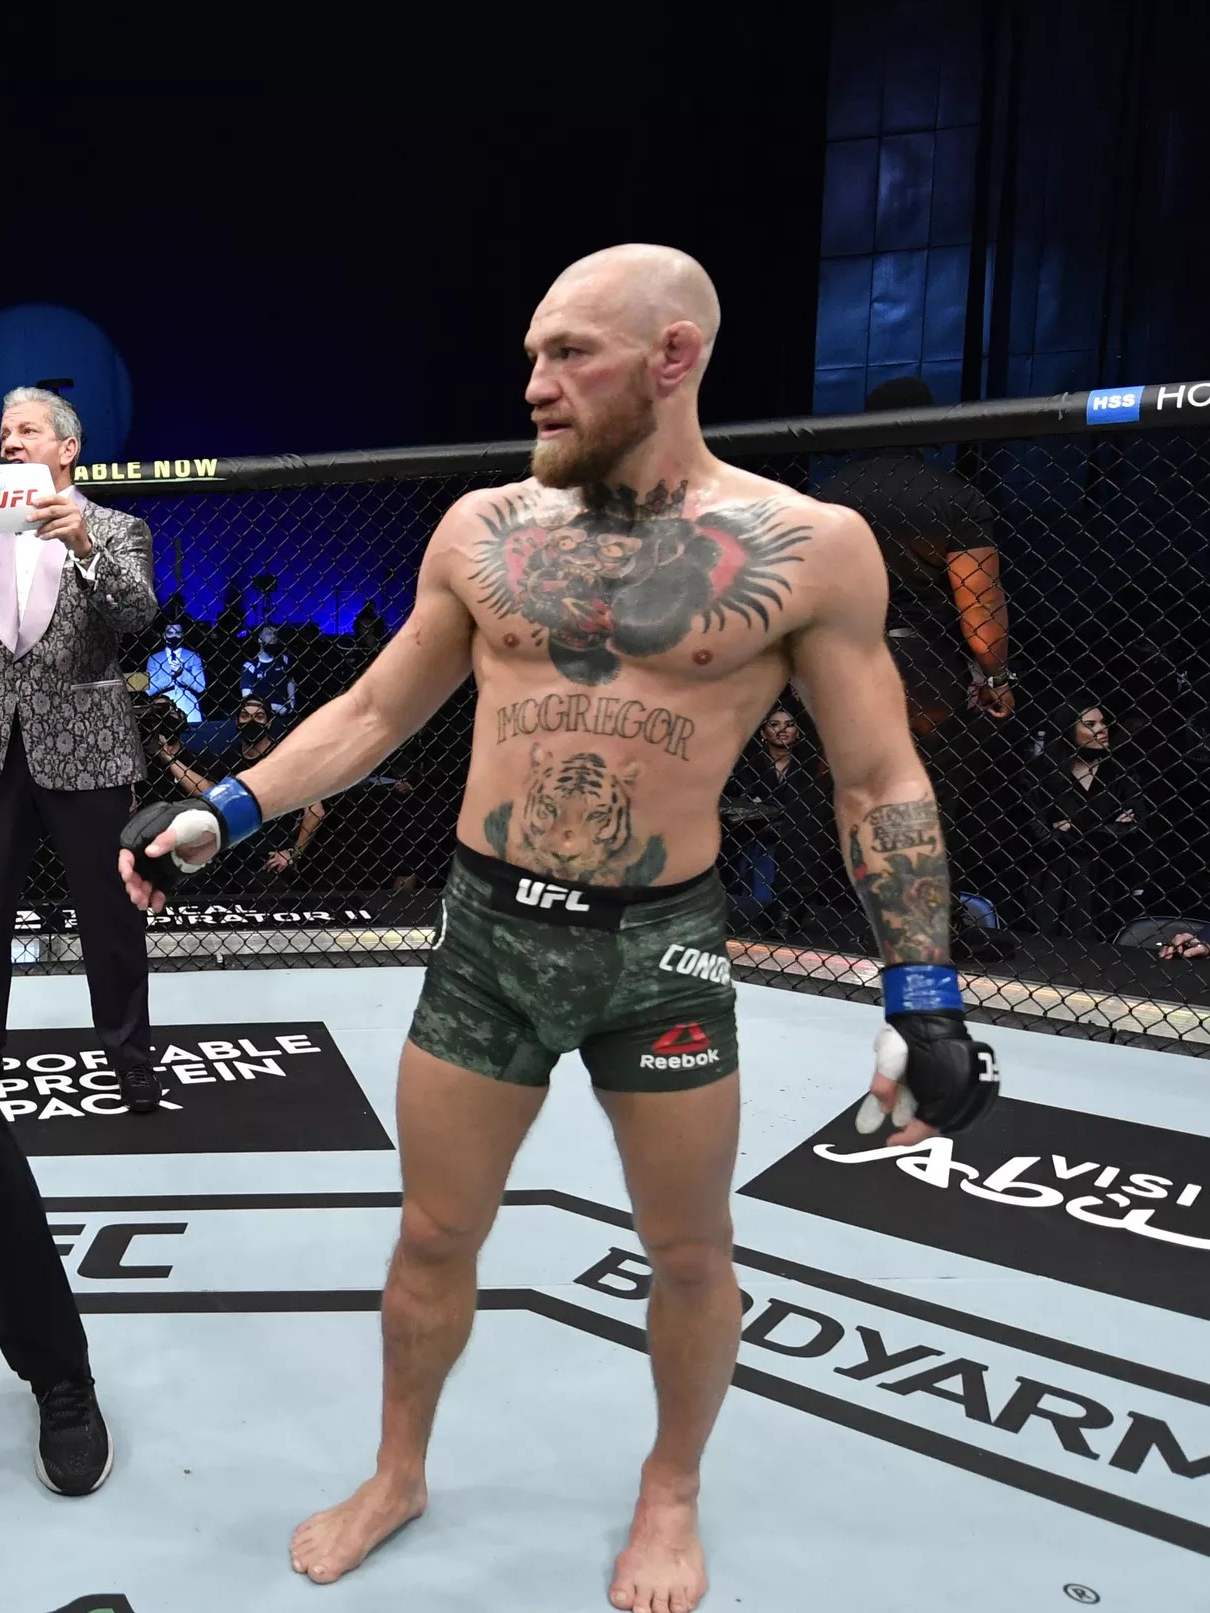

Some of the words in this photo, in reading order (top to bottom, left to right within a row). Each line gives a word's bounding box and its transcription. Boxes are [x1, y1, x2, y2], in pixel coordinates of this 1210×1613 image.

[1093, 393, 1136, 410] HSS
[74, 462, 141, 481] ABLE
[154, 458, 218, 478] NOW
[496, 693, 695, 762] MCGREGOR
[147, 910, 336, 926] PIRATOR
[2, 1034, 322, 1071] PORABLE
[640, 1049, 720, 1070] Reebok
[1051, 1154, 1202, 1207] VISI
[573, 1246, 1210, 1479] BDYARM
